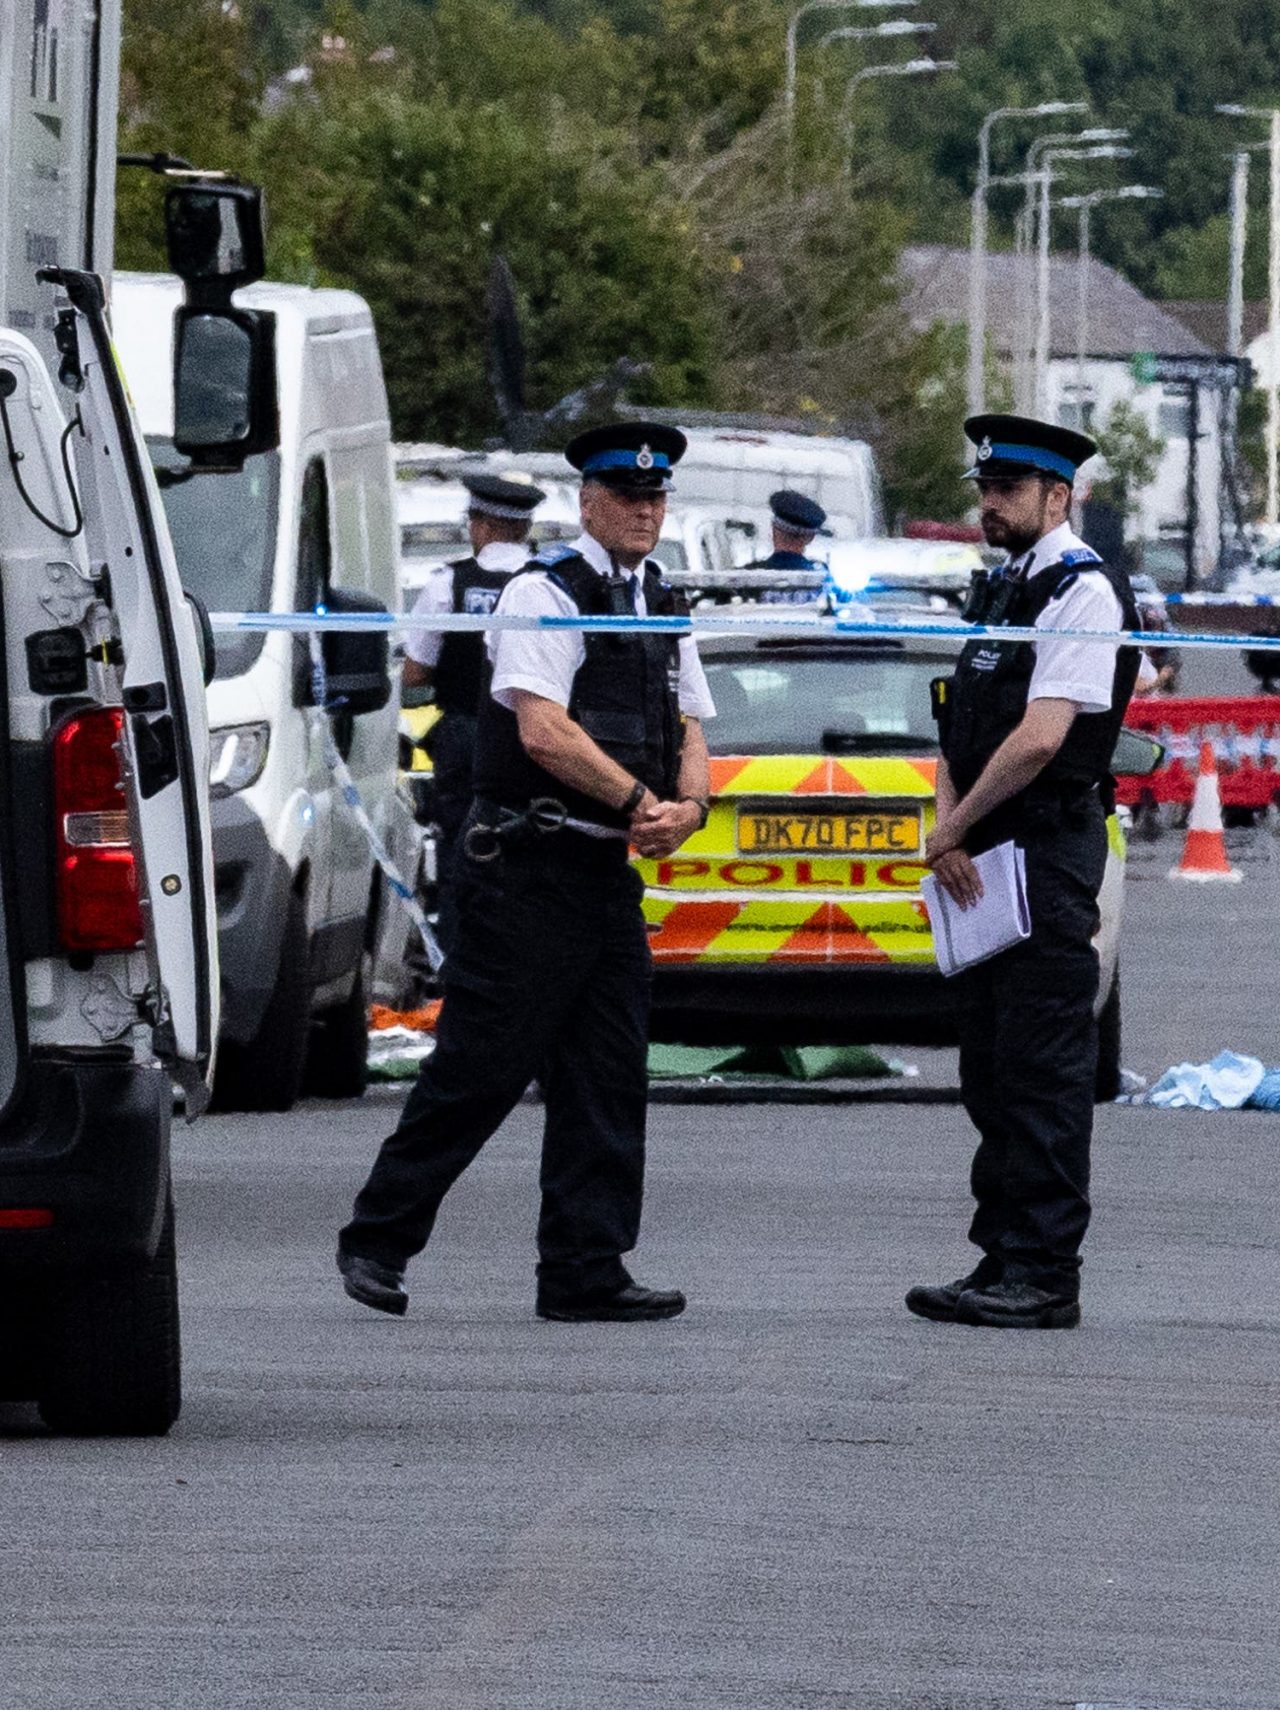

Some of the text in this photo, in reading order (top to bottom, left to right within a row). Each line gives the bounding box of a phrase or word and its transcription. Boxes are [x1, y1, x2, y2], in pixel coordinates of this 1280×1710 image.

[753, 818, 906, 847] DK70 FPC
[657, 861, 931, 886] POLIC
